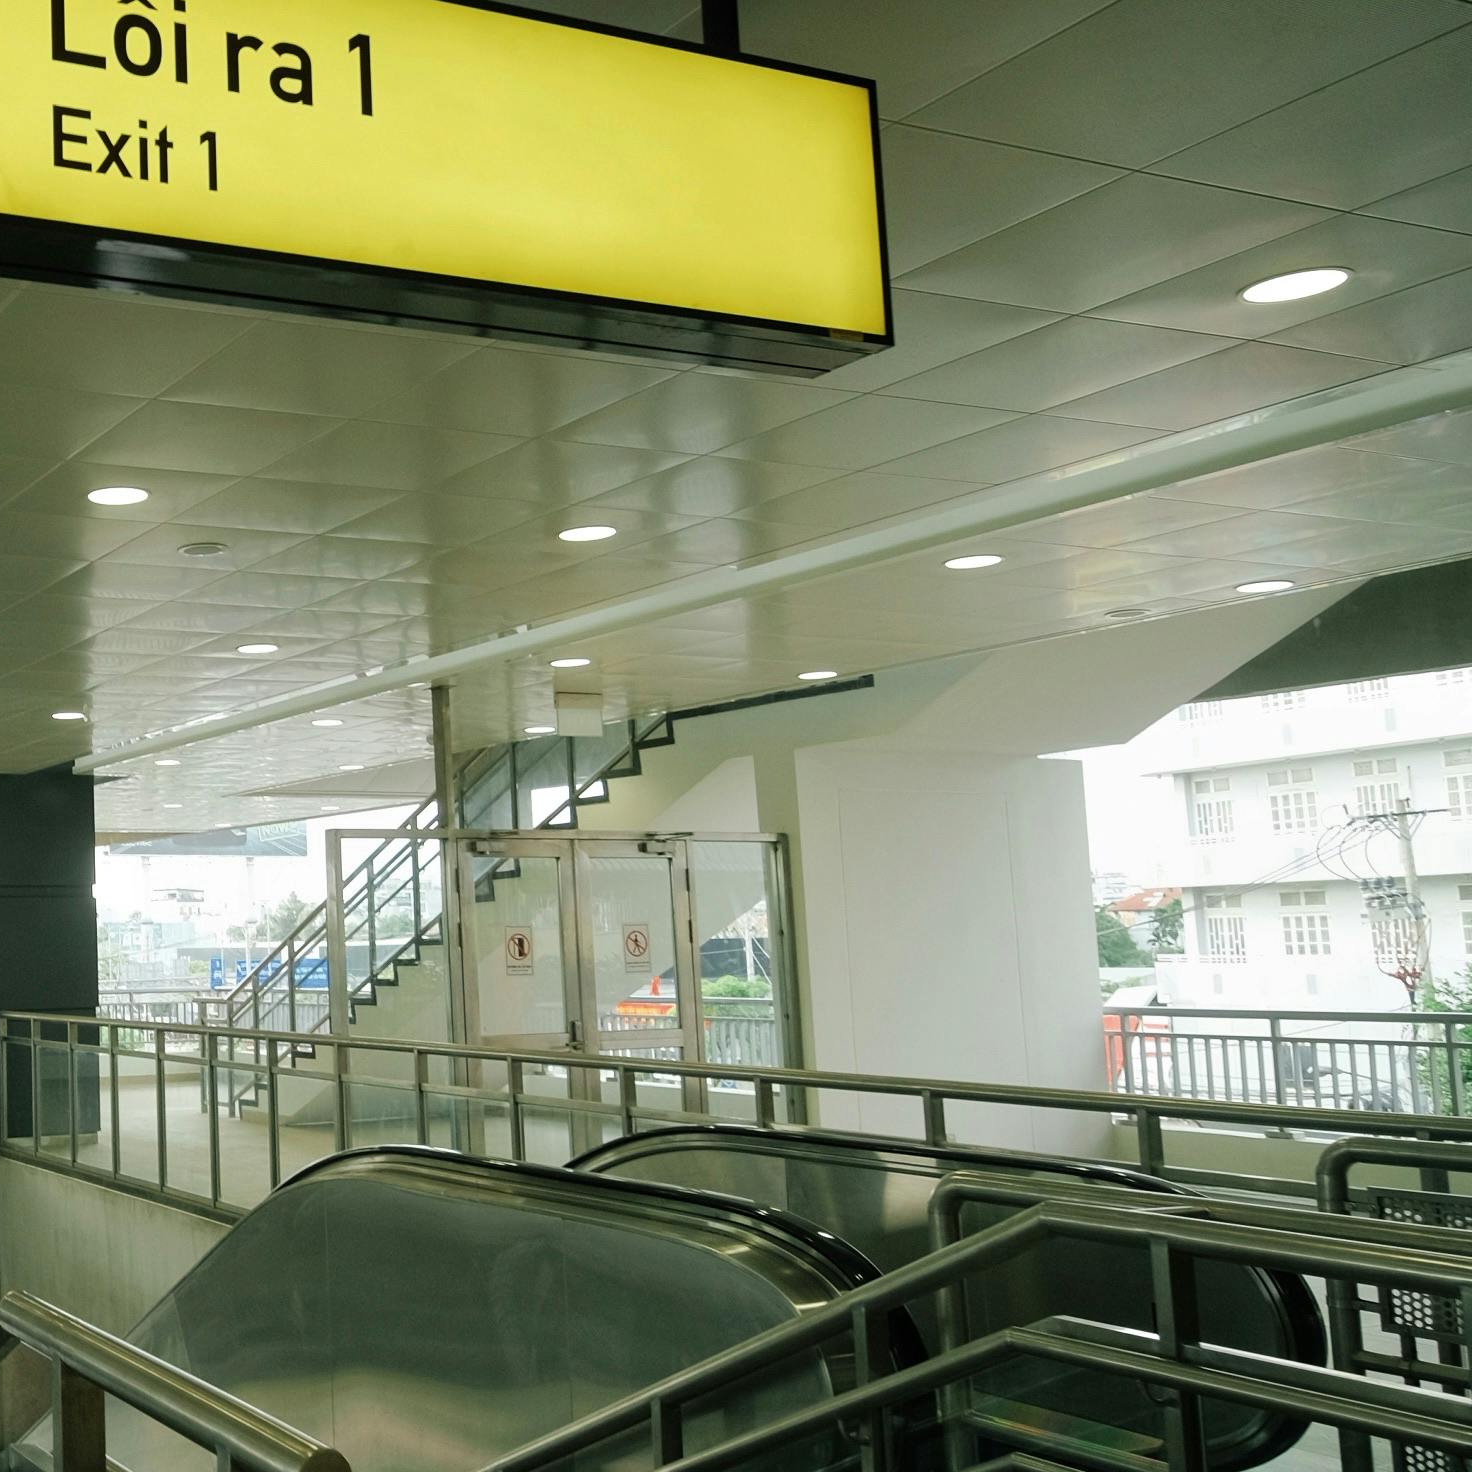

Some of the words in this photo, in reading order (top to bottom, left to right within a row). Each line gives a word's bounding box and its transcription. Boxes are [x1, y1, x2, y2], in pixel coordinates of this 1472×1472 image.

[227, 32, 313, 106] ra
[348, 34, 373, 116] 1
[53, 105, 173, 184] Exit
[199, 131, 217, 191] 1
